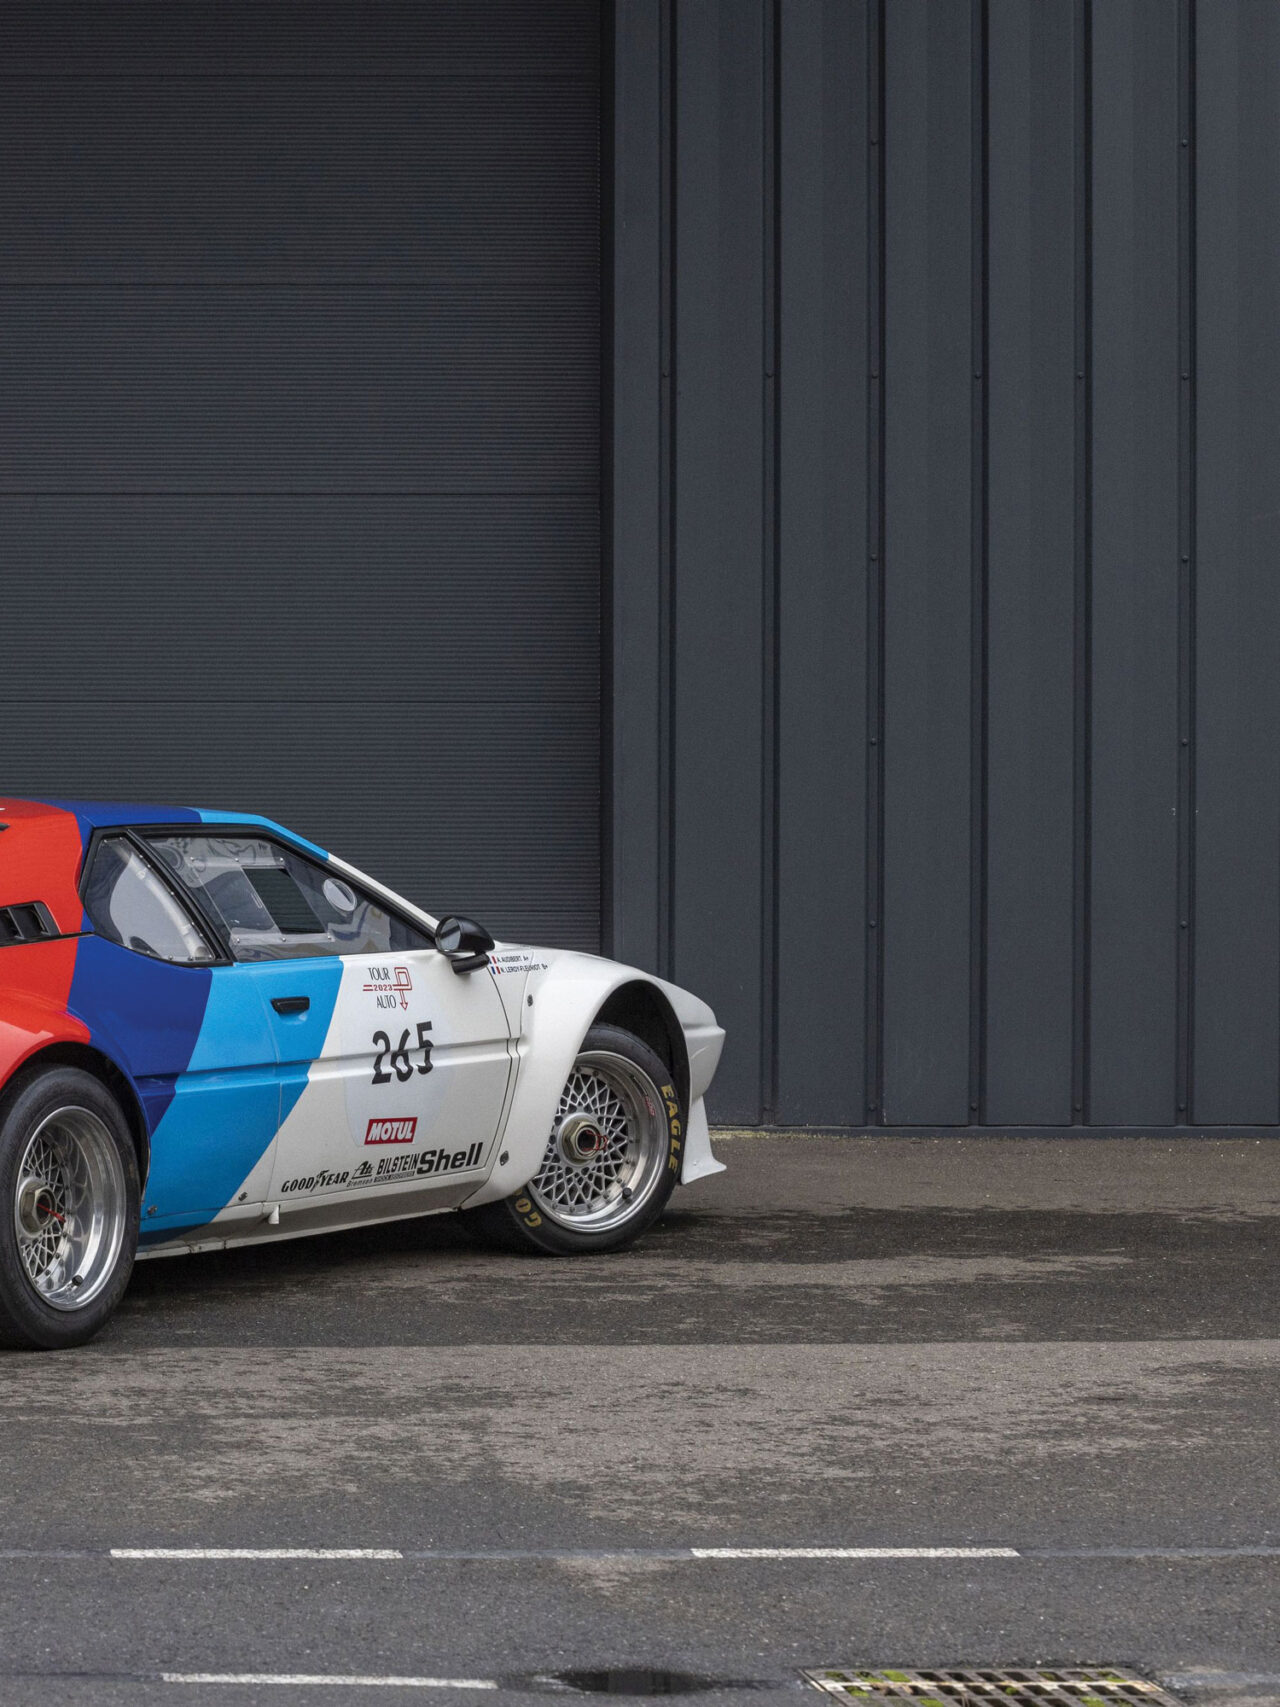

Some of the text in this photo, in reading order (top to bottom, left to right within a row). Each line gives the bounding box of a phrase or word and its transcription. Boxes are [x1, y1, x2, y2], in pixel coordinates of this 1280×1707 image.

[367, 967, 391, 981] TOUR
[376, 994, 397, 1009] AUTO
[371, 1020, 434, 1085] 265
[368, 1120, 415, 1142] MOTUL
[661, 1085, 681, 1174] EAGLE
[376, 1153, 421, 1176] BILSTEIN
[416, 1142, 484, 1175] Shell
[281, 1169, 350, 1193] GOODYEAR
